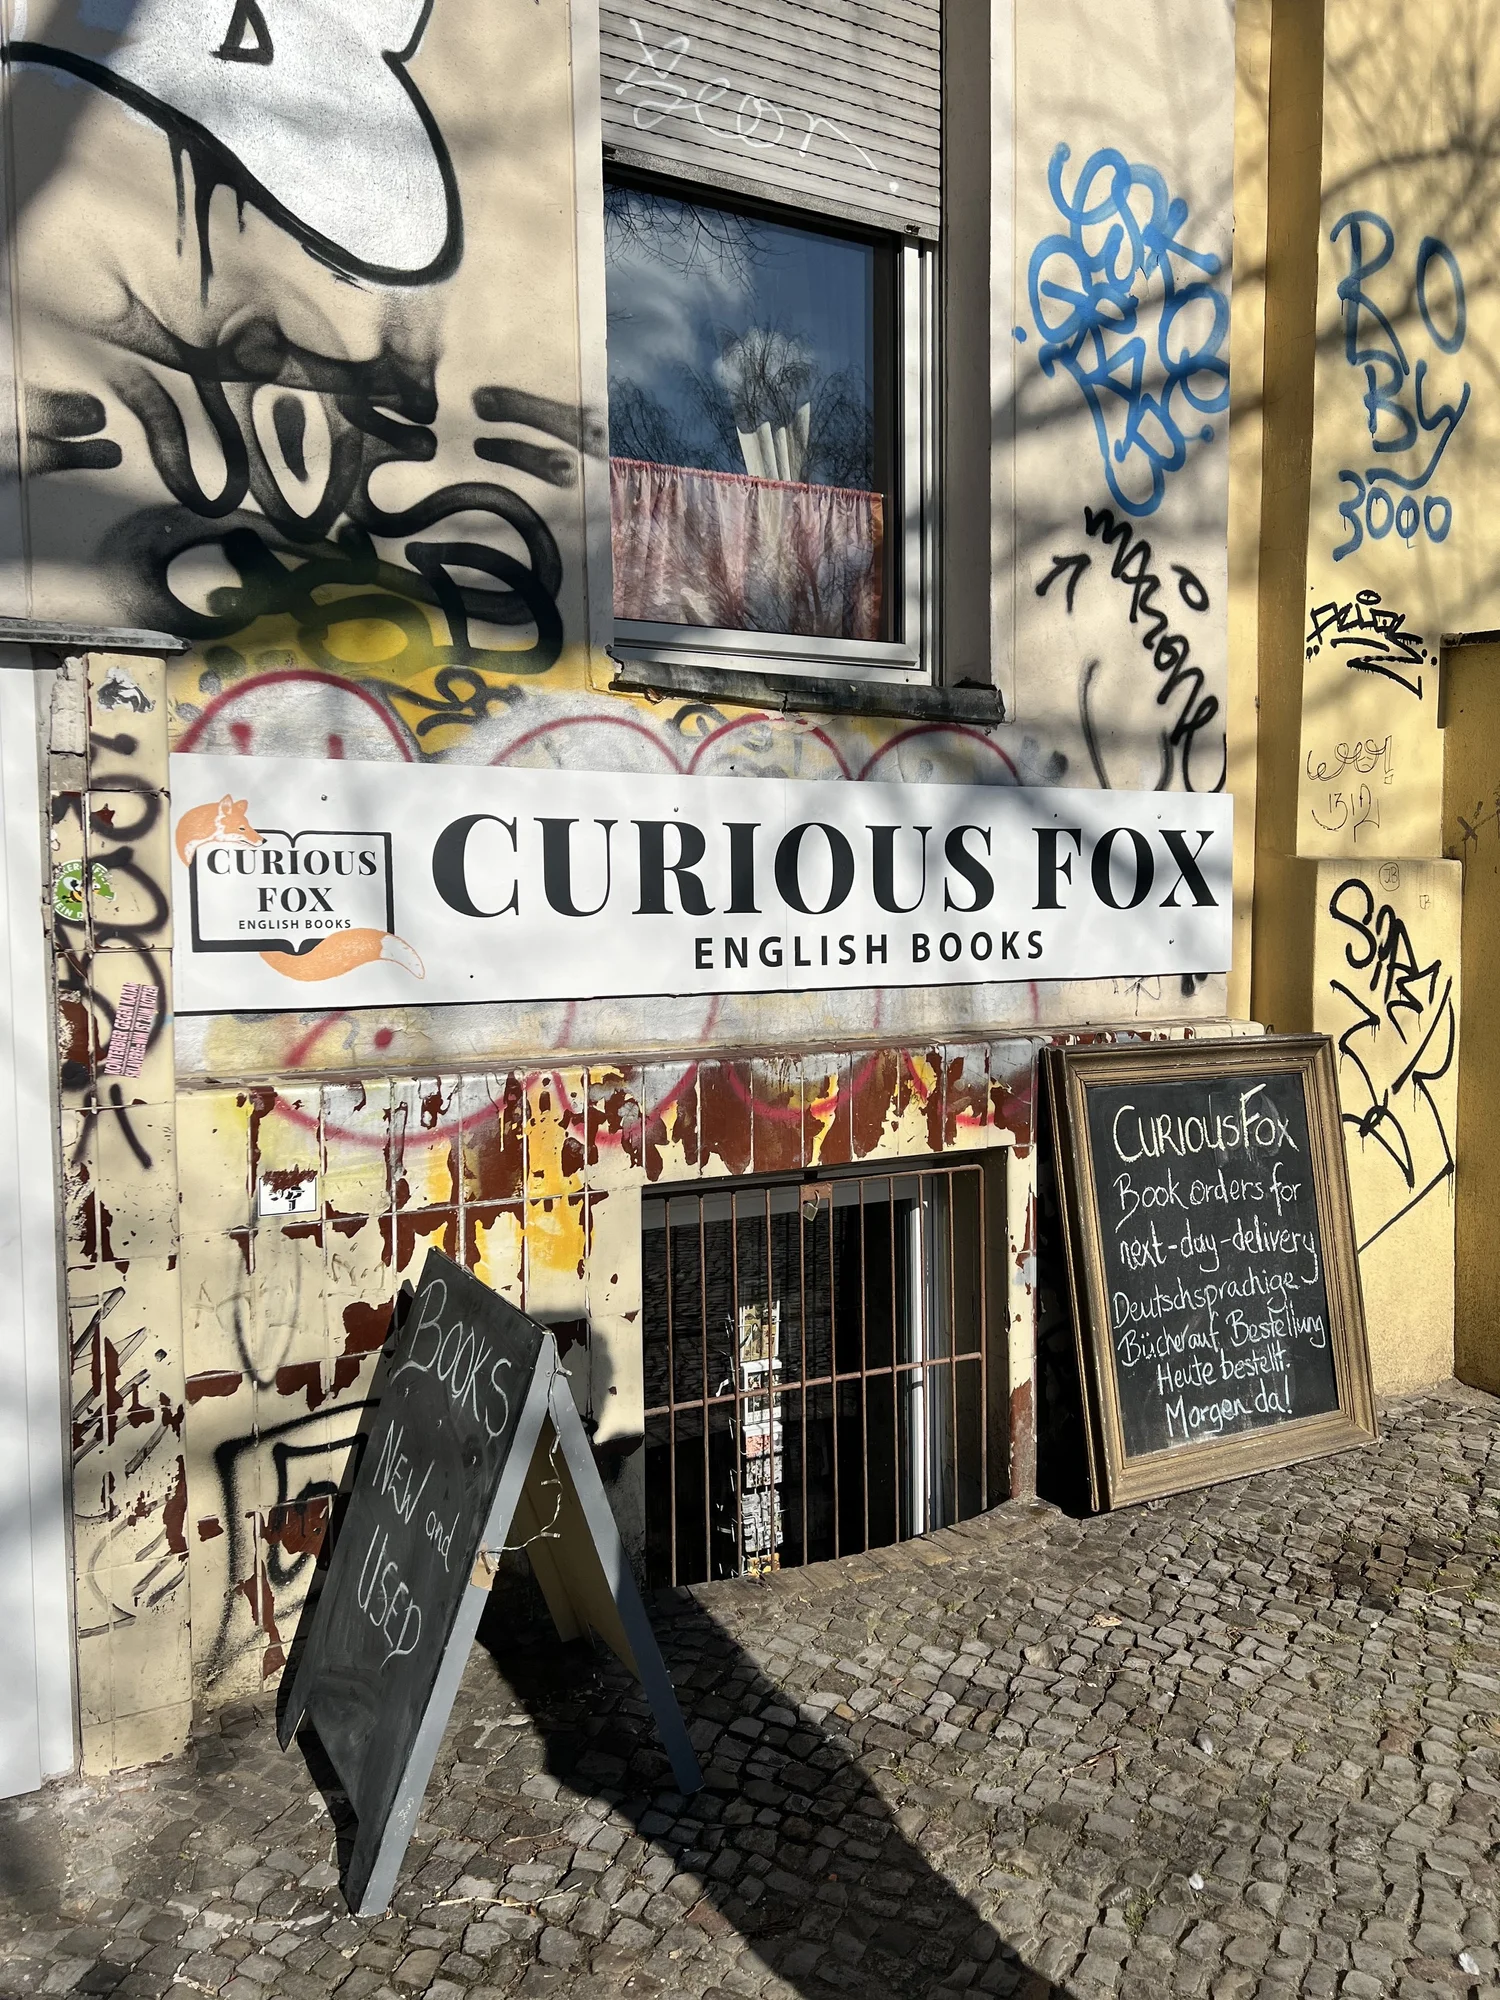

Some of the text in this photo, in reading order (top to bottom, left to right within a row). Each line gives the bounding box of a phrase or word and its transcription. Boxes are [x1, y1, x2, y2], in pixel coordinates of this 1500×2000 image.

[1333, 470, 1452, 562] 3000
[206, 848, 377, 877] CURIOUS
[432, 814, 1219, 918] CURIOUS FOX
[257, 887, 335, 914] FOX
[238, 918, 352, 932] ENGLISH BOOKS
[695, 930, 1044, 970] ENGLISH BOOKS
[120, 982, 140, 1006] KATAR
[137, 1005, 155, 1022] ZUM
[114, 1005, 135, 1030] GEGEN
[135, 1021, 152, 1032] IST
[104, 1029, 130, 1075] KONTERBIER
[1113, 1161, 1301, 1232] Book orders for
[1119, 1214, 1320, 1285] next-day-delivery
[1113, 1268, 1301, 1330] Deutschsprachige
[1225, 1302, 1326, 1349] Bestellung
[391, 1277, 511, 1438] BOOKS
[1157, 1360, 1217, 1396] Heute
[1165, 1375, 1293, 1438] Morgen da!
[372, 1418, 460, 1573] NEW and
[356, 1523, 423, 1672] USED
